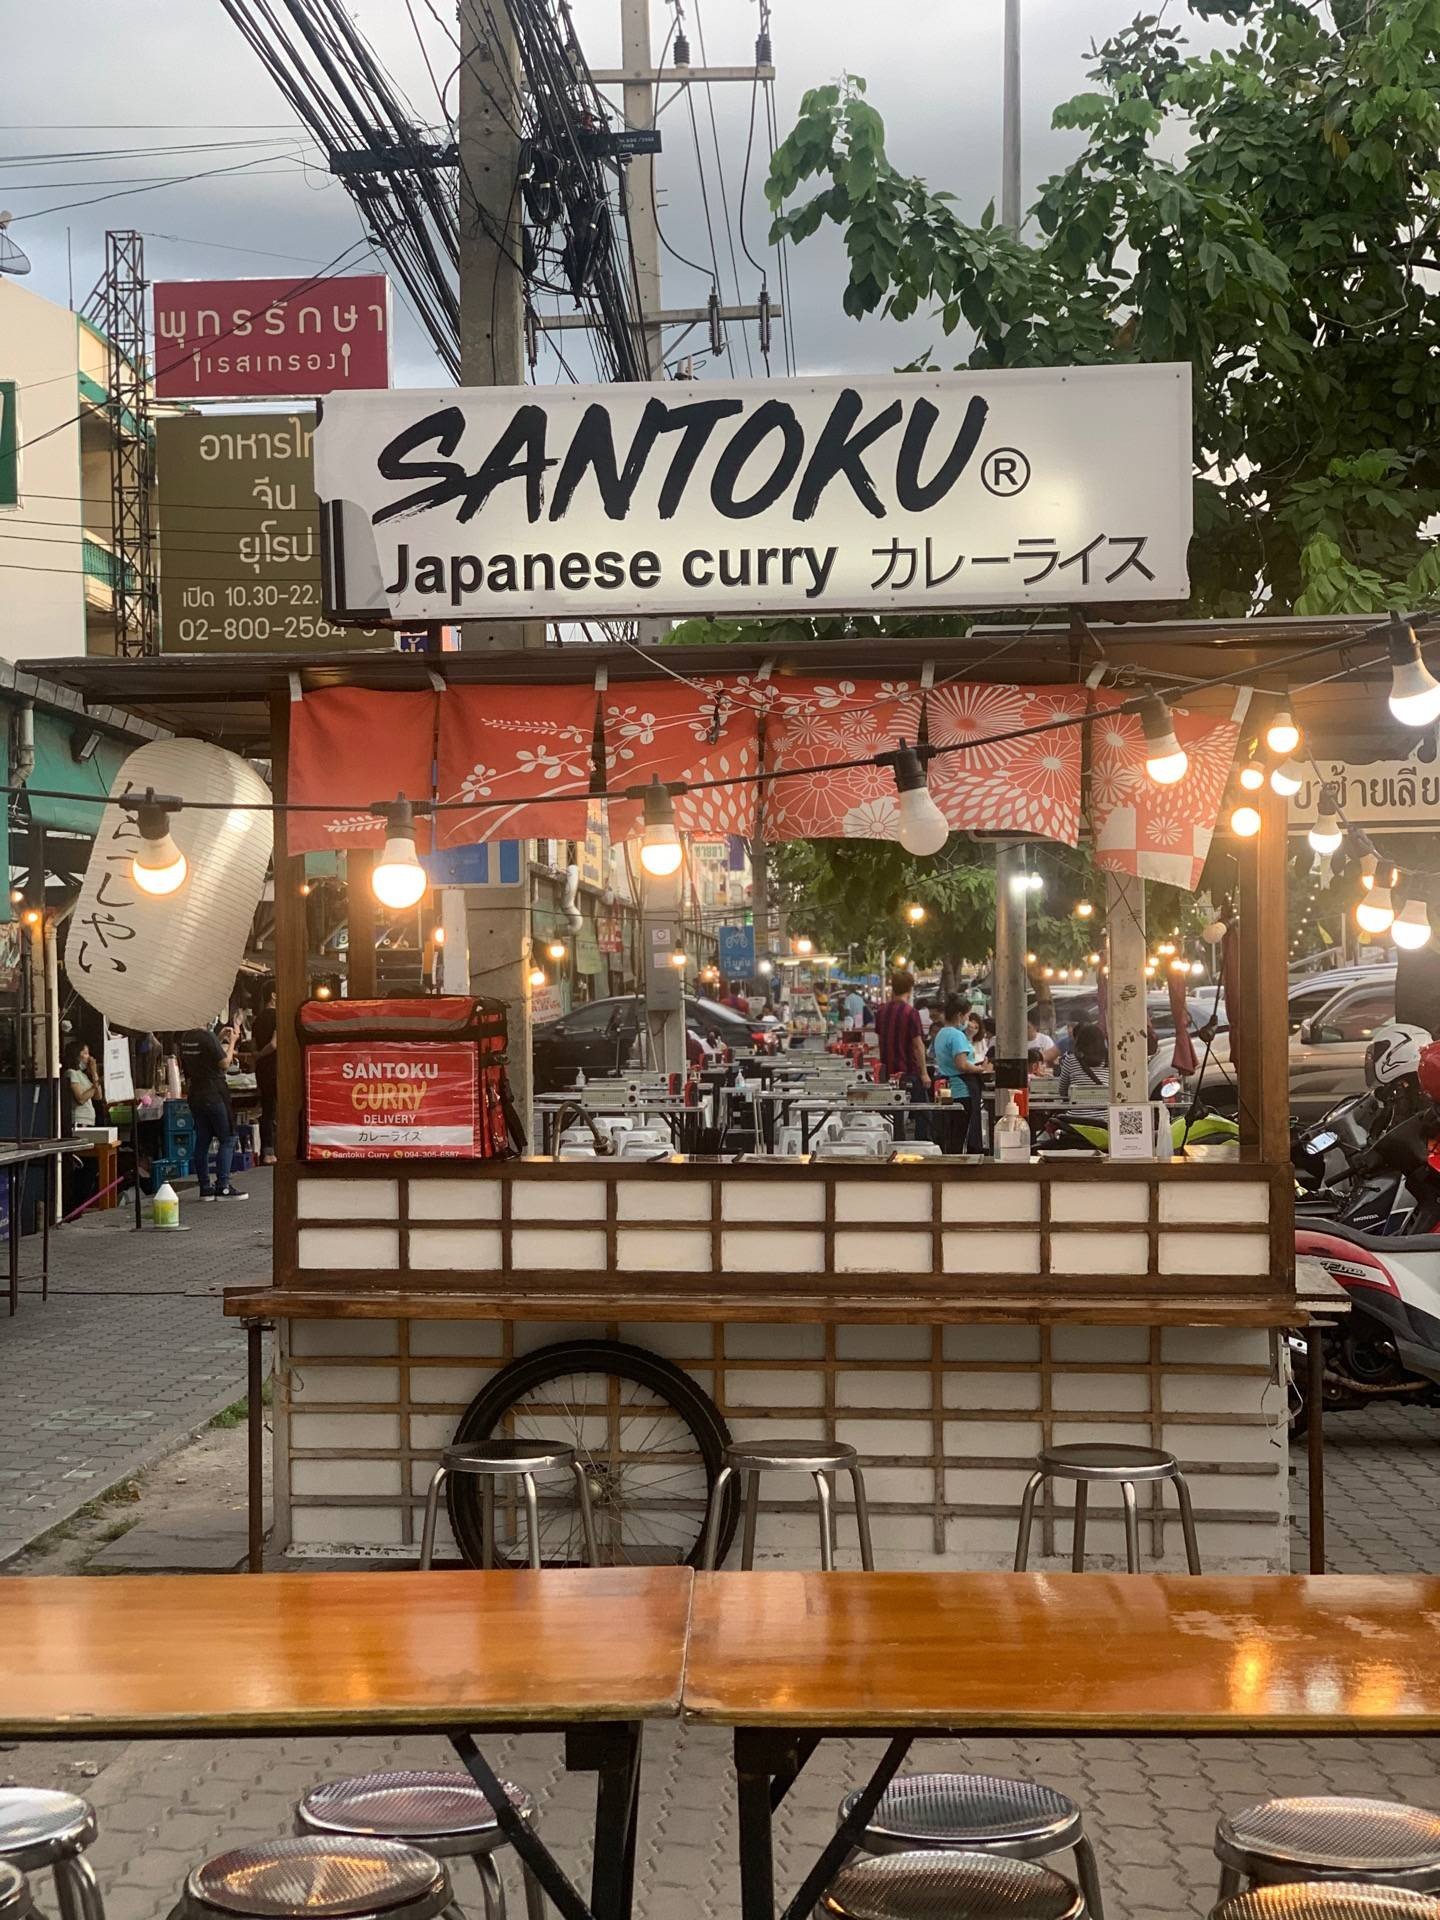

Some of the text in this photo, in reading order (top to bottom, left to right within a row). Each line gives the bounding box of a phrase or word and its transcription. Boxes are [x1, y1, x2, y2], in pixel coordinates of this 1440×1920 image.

[160, 300, 383, 349] พุทธรักษา
[371, 388, 989, 525] SANTOKU
[252, 476, 296, 510] จีน
[239, 520, 312, 574] ยุโรป
[385, 534, 1156, 606] Japanese curry カレーライス
[183, 584, 323, 608] เปิด 10.30-22.
[342, 1062, 439, 1079] SANTOKU
[351, 1081, 427, 1110] CURRY
[363, 1114, 416, 1124] DELIVERY
[358, 1131, 421, 1142] カレーライス
[332, 1151, 366, 1159] Santoku
[367, 1151, 390, 1159] Curry
[1353, 1214, 1379, 1222] HONDA
